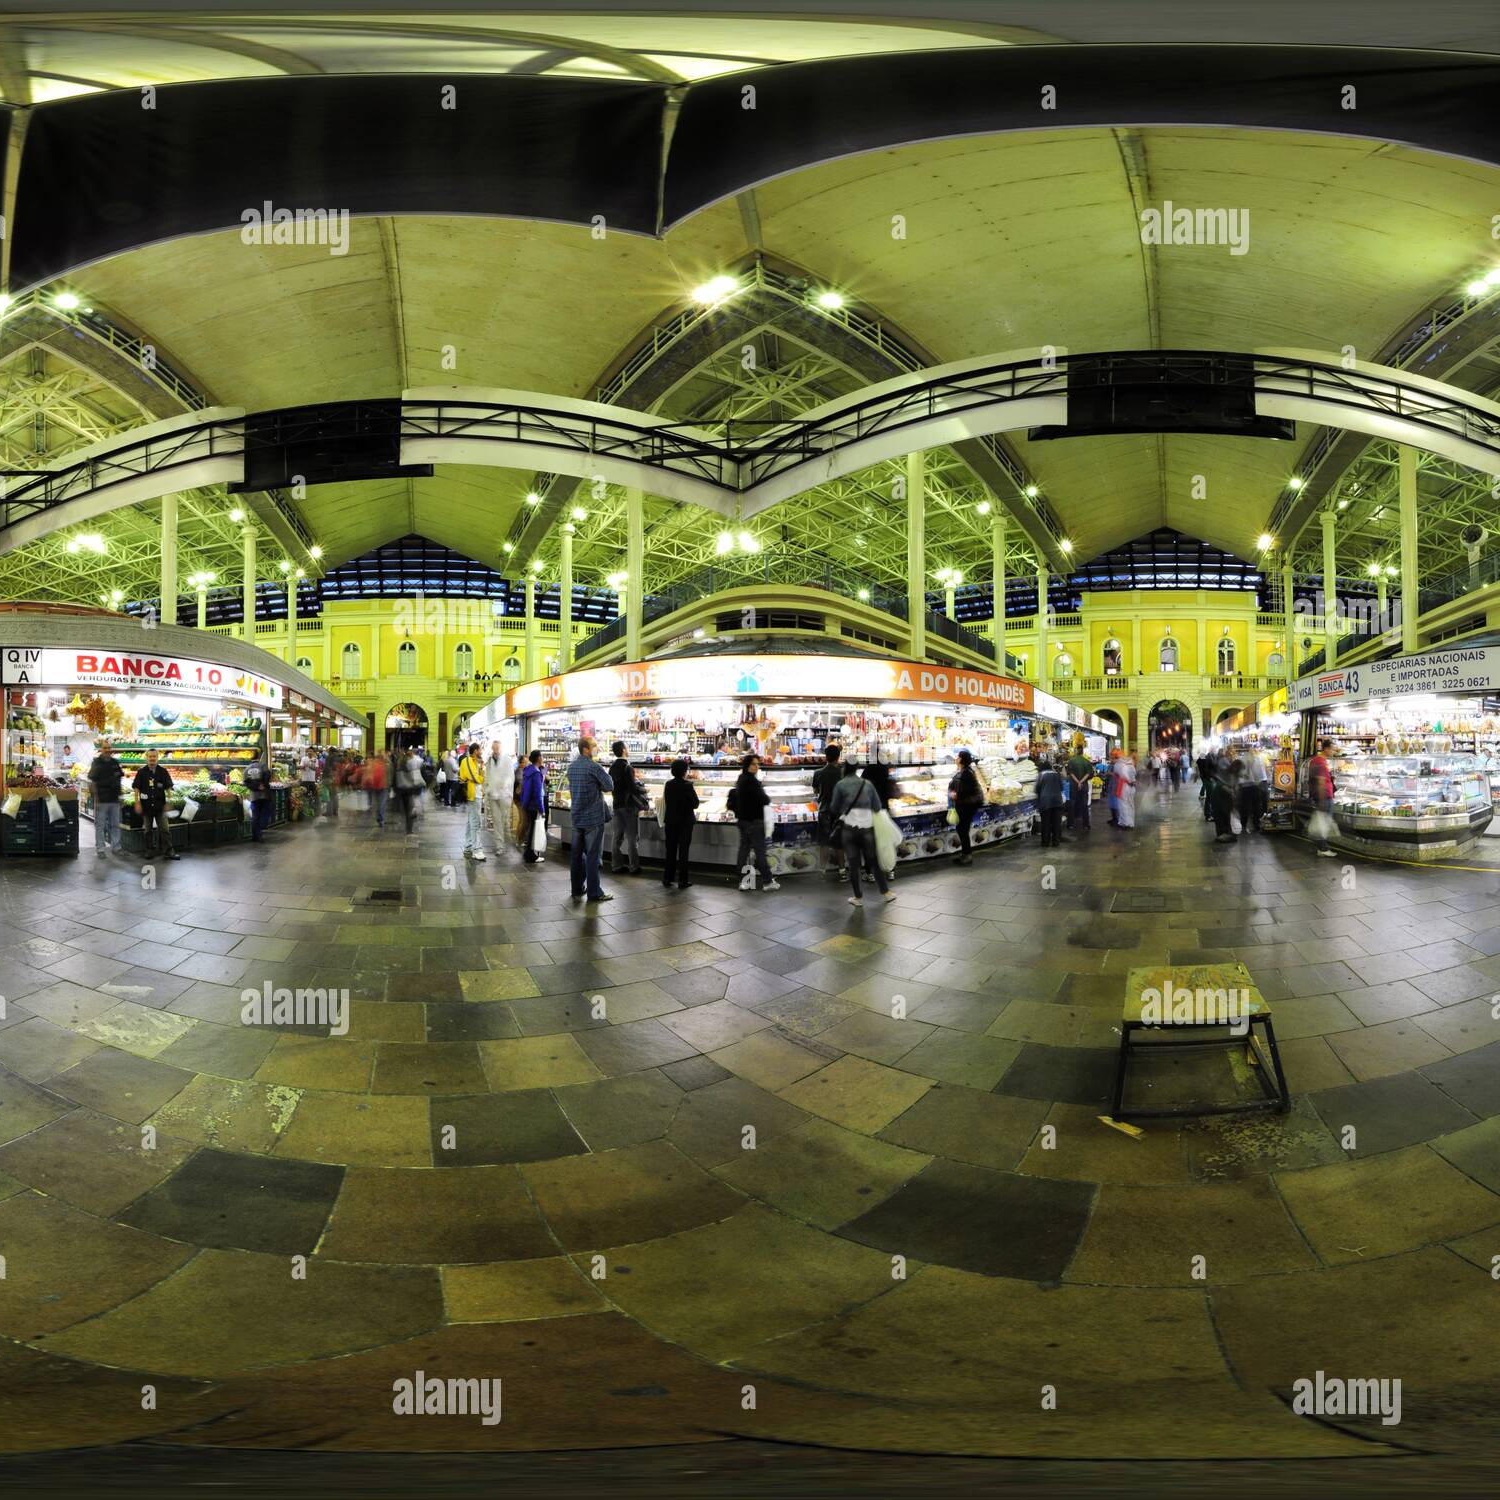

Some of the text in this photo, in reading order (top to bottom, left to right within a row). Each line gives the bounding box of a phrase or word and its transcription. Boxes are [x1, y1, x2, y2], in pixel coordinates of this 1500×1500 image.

[7, 649, 40, 663] Q IV
[1370, 650, 1486, 674] ESPECIARIAS NACIONAIS
[18, 670, 30, 683] A
[76, 655, 223, 685] BANCA 10
[1390, 665, 1460, 682] E IMPORTADAS
[76, 675, 129, 684] VERDURAS
[139, 678, 172, 687] FRUTAS
[920, 671, 949, 693] DO
[955, 675, 1025, 703] HOLANDÊS
[1318, 671, 1359, 694] BANCA 43
[1368, 677, 1491, 697] Fones: 3224 3861 3225 0621
[543, 683, 561, 703] DO
[1298, 687, 1312, 699] VISA
